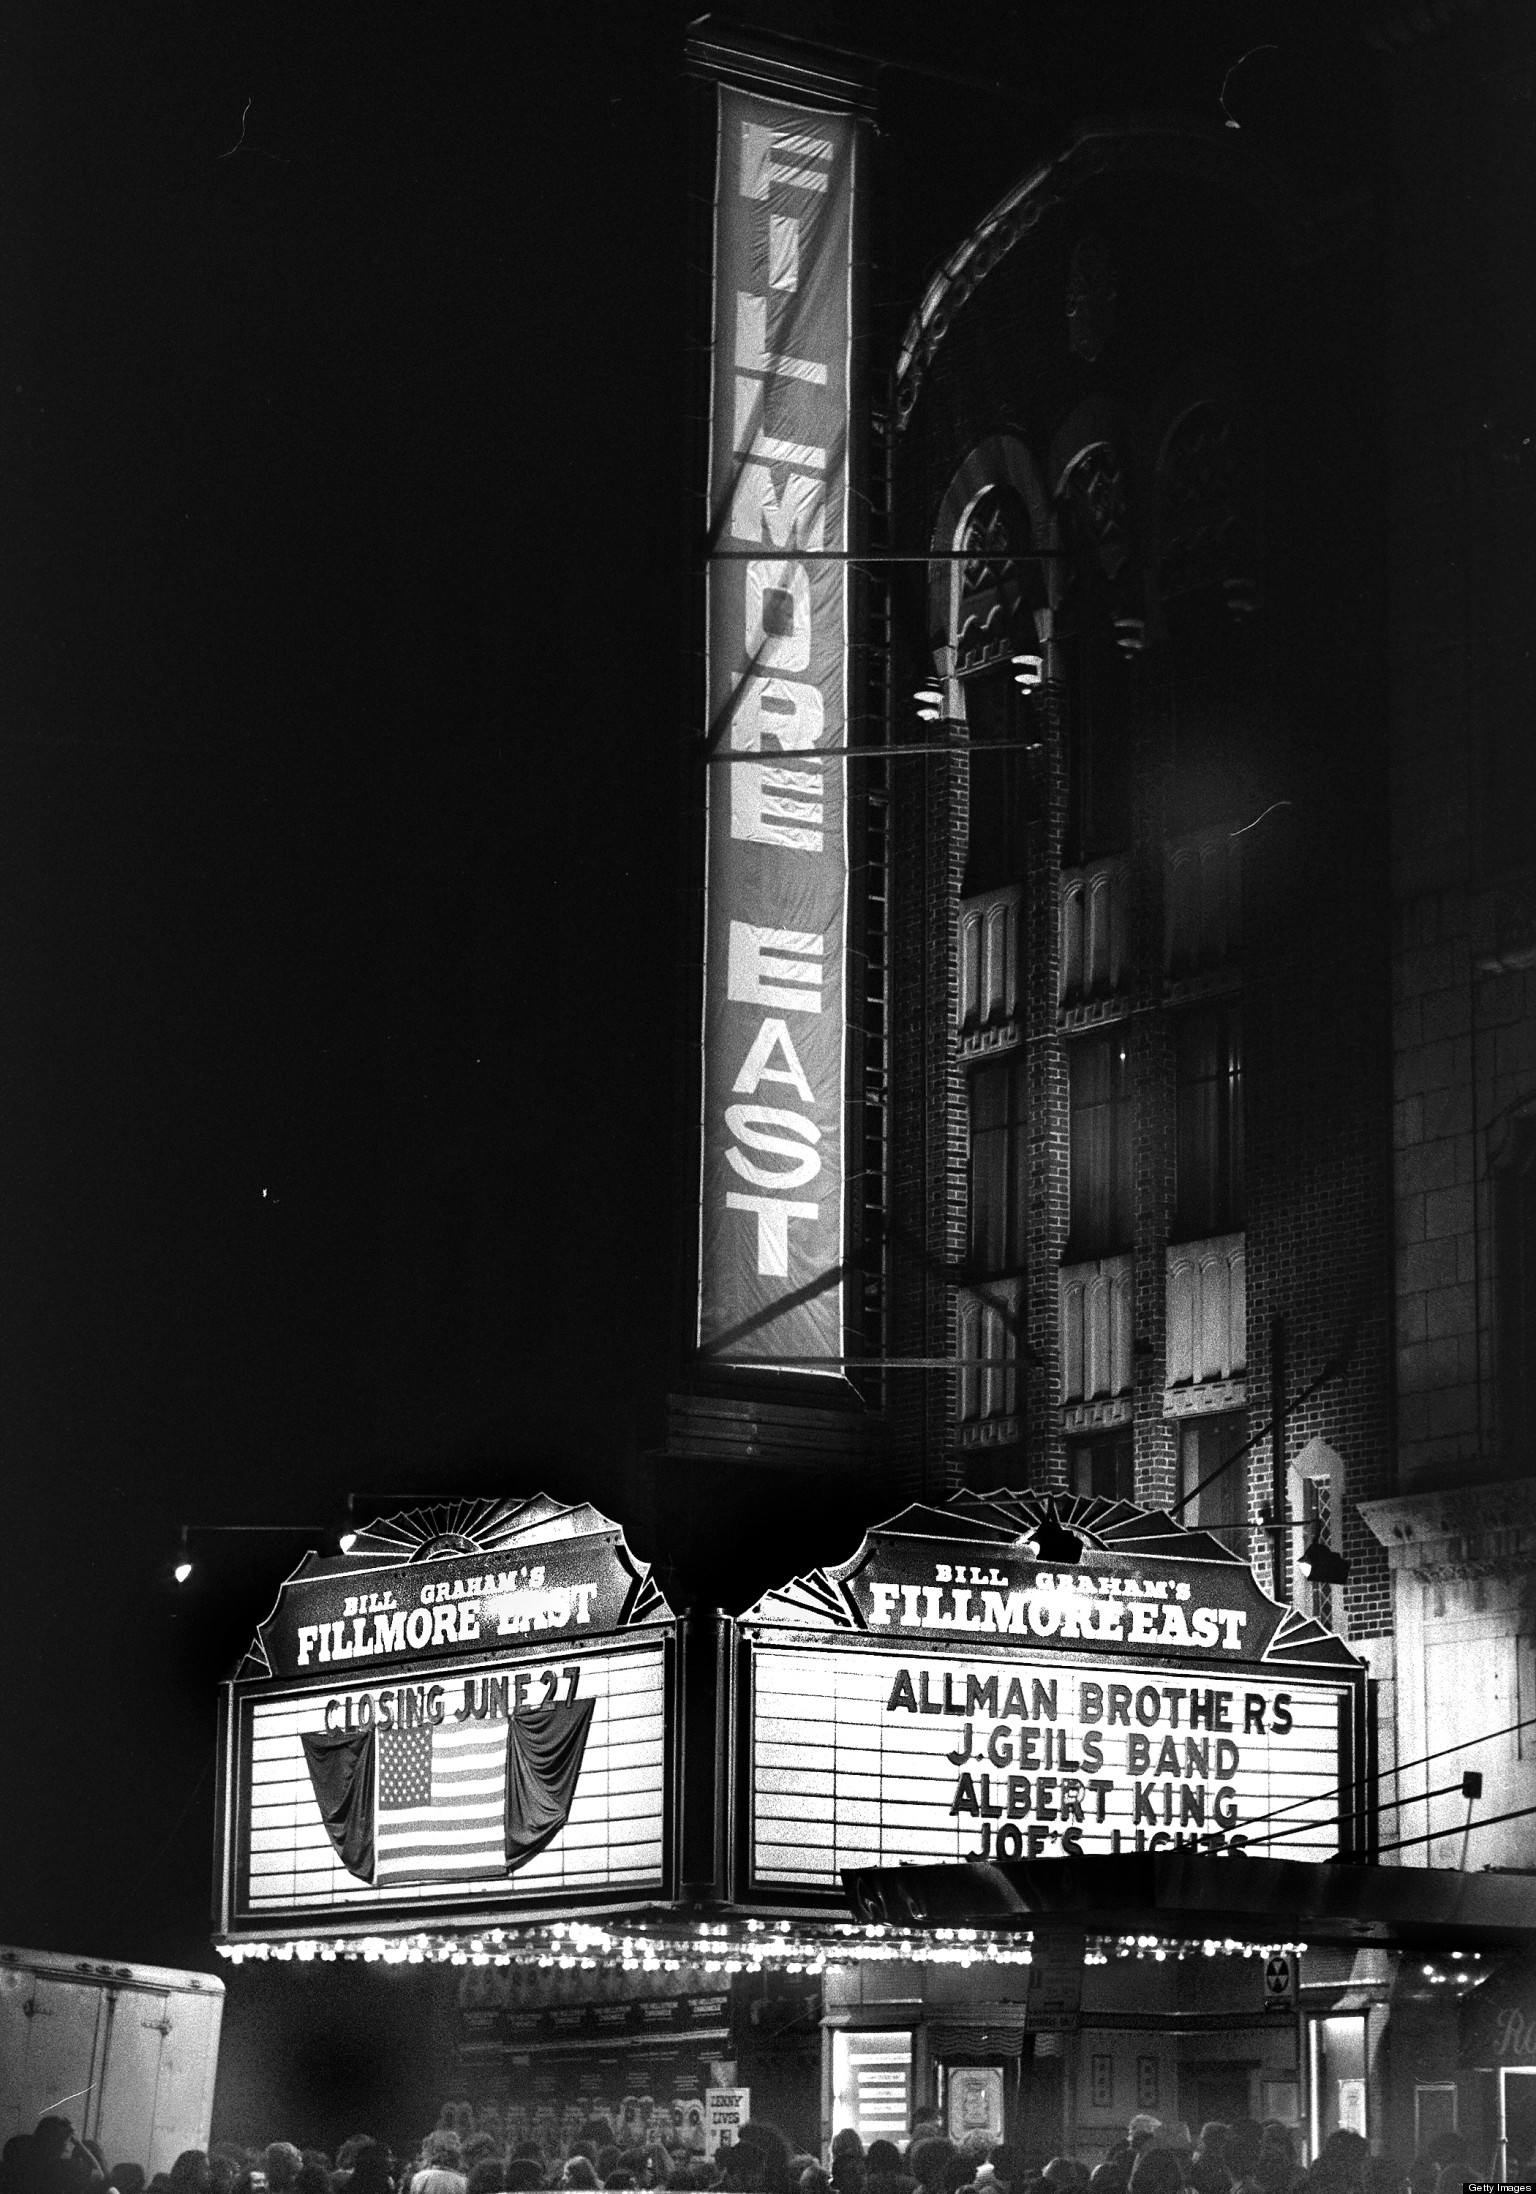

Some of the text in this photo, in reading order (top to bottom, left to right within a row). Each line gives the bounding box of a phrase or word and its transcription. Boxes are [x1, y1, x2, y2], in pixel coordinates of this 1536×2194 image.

[723, 120, 834, 1278] FILLMORE EAST
[343, 1565, 547, 1617] BILL GRAHAM'S
[935, 1563, 1191, 1601] BILL GRAHAM'S
[297, 1598, 481, 1666] FILLMORE
[869, 1581, 1247, 1650] FILLMORE EAST
[324, 1665, 581, 1738] CLOSING JUNE 27
[886, 1669, 1293, 1735] ALLMAN BROTHERS
[1125, 1732, 1240, 1781] BAND
[949, 1771, 1239, 1830] ALBERT KING
[965, 1822, 1084, 1862] JOE'S
[712, 2111, 740, 2125] LIVES
